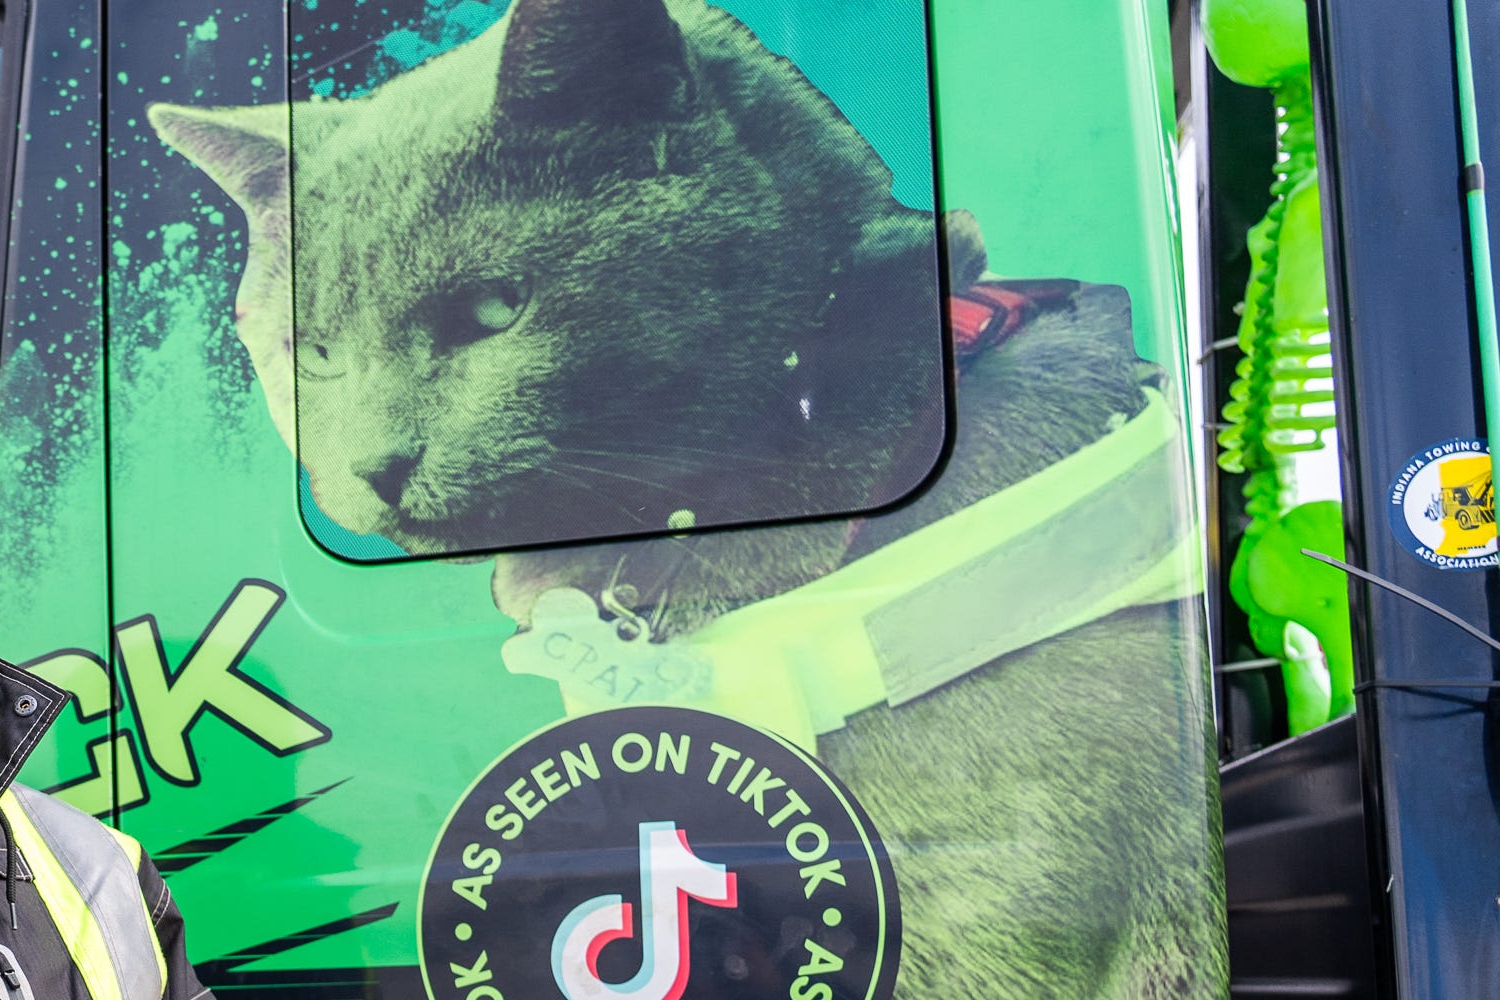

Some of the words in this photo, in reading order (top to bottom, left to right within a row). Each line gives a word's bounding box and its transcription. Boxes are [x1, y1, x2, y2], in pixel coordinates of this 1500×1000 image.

[1391, 459, 1425, 505] INDIANA
[1425, 441, 1480, 461] TOWING
[1415, 546, 1499, 569] ASSOCIATION
[19, 579, 331, 817] CK
[451, 843, 501, 911] AS
[485, 742, 601, 841] SEEN
[611, 732, 691, 775] ON
[706, 741, 847, 900] TIKTOK
